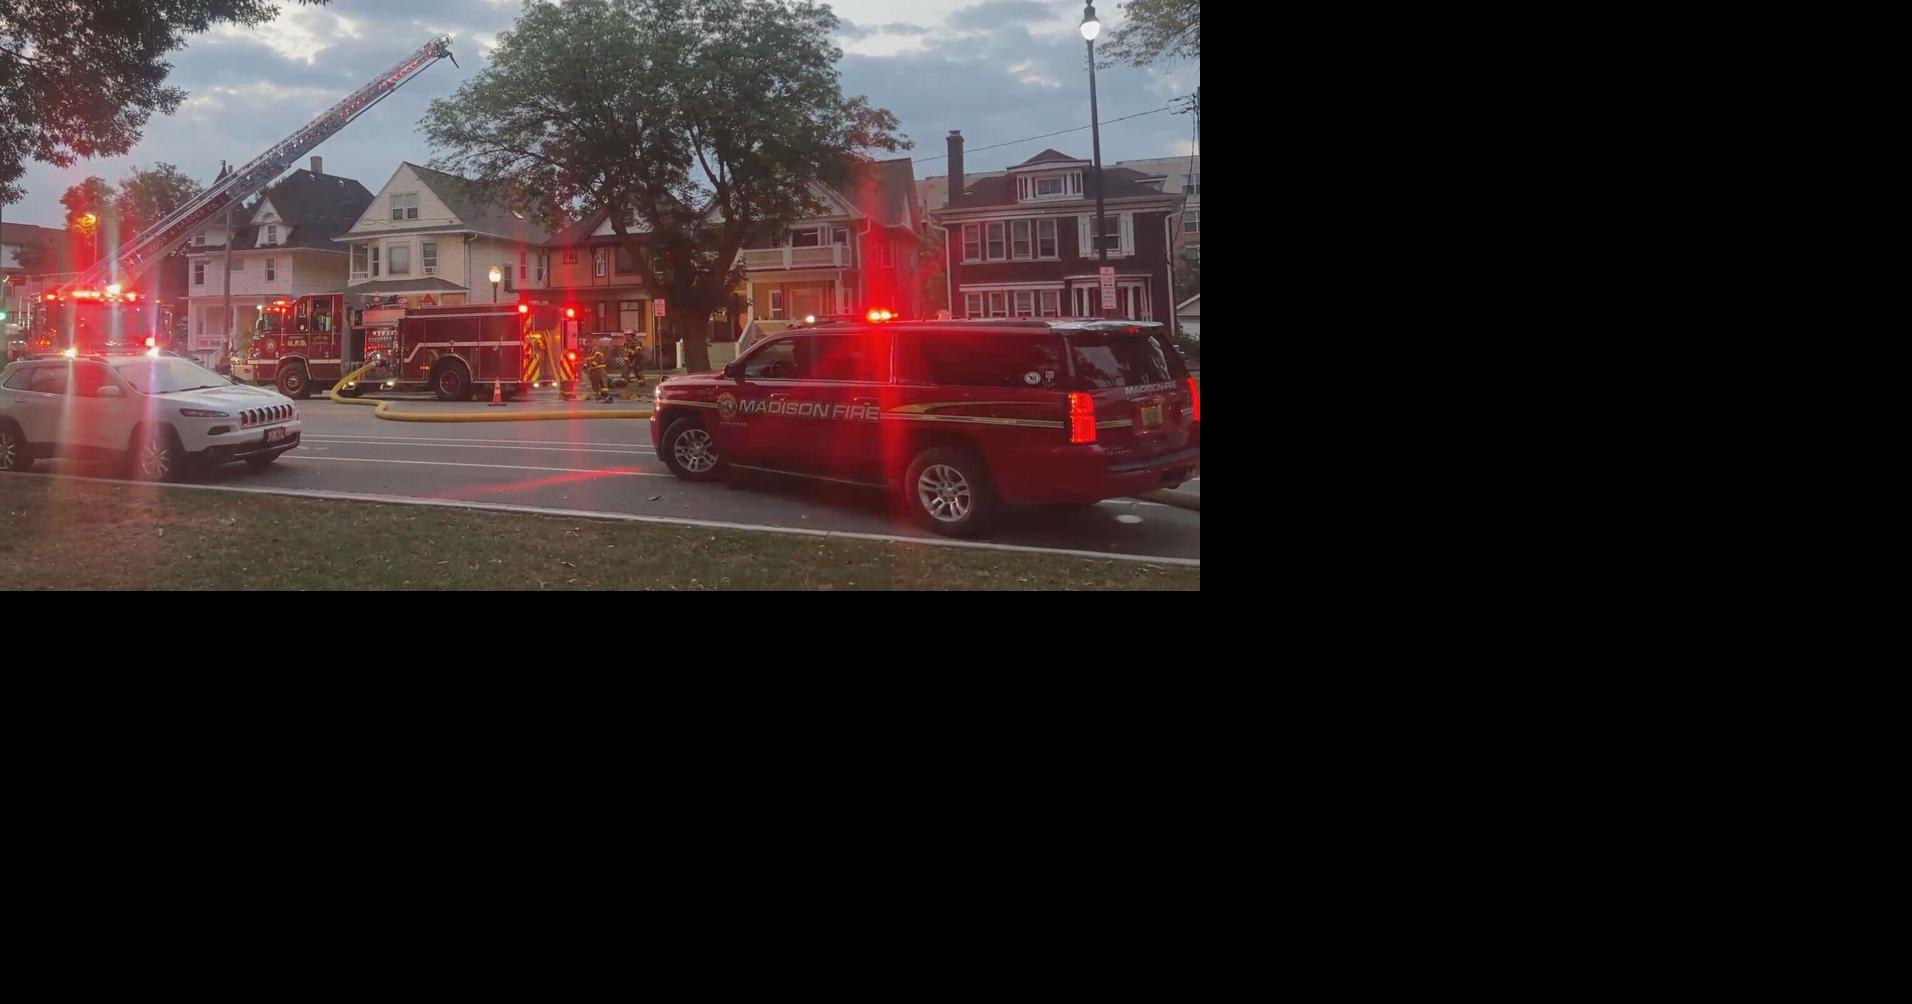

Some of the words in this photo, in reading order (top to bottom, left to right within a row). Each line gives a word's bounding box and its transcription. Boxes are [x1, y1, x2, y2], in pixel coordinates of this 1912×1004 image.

[177, 209, 206, 230] LADDER
[1125, 383, 1164, 395] MADISON
[739, 400, 828, 417] MADISON
[833, 406, 880, 420] FIRE
